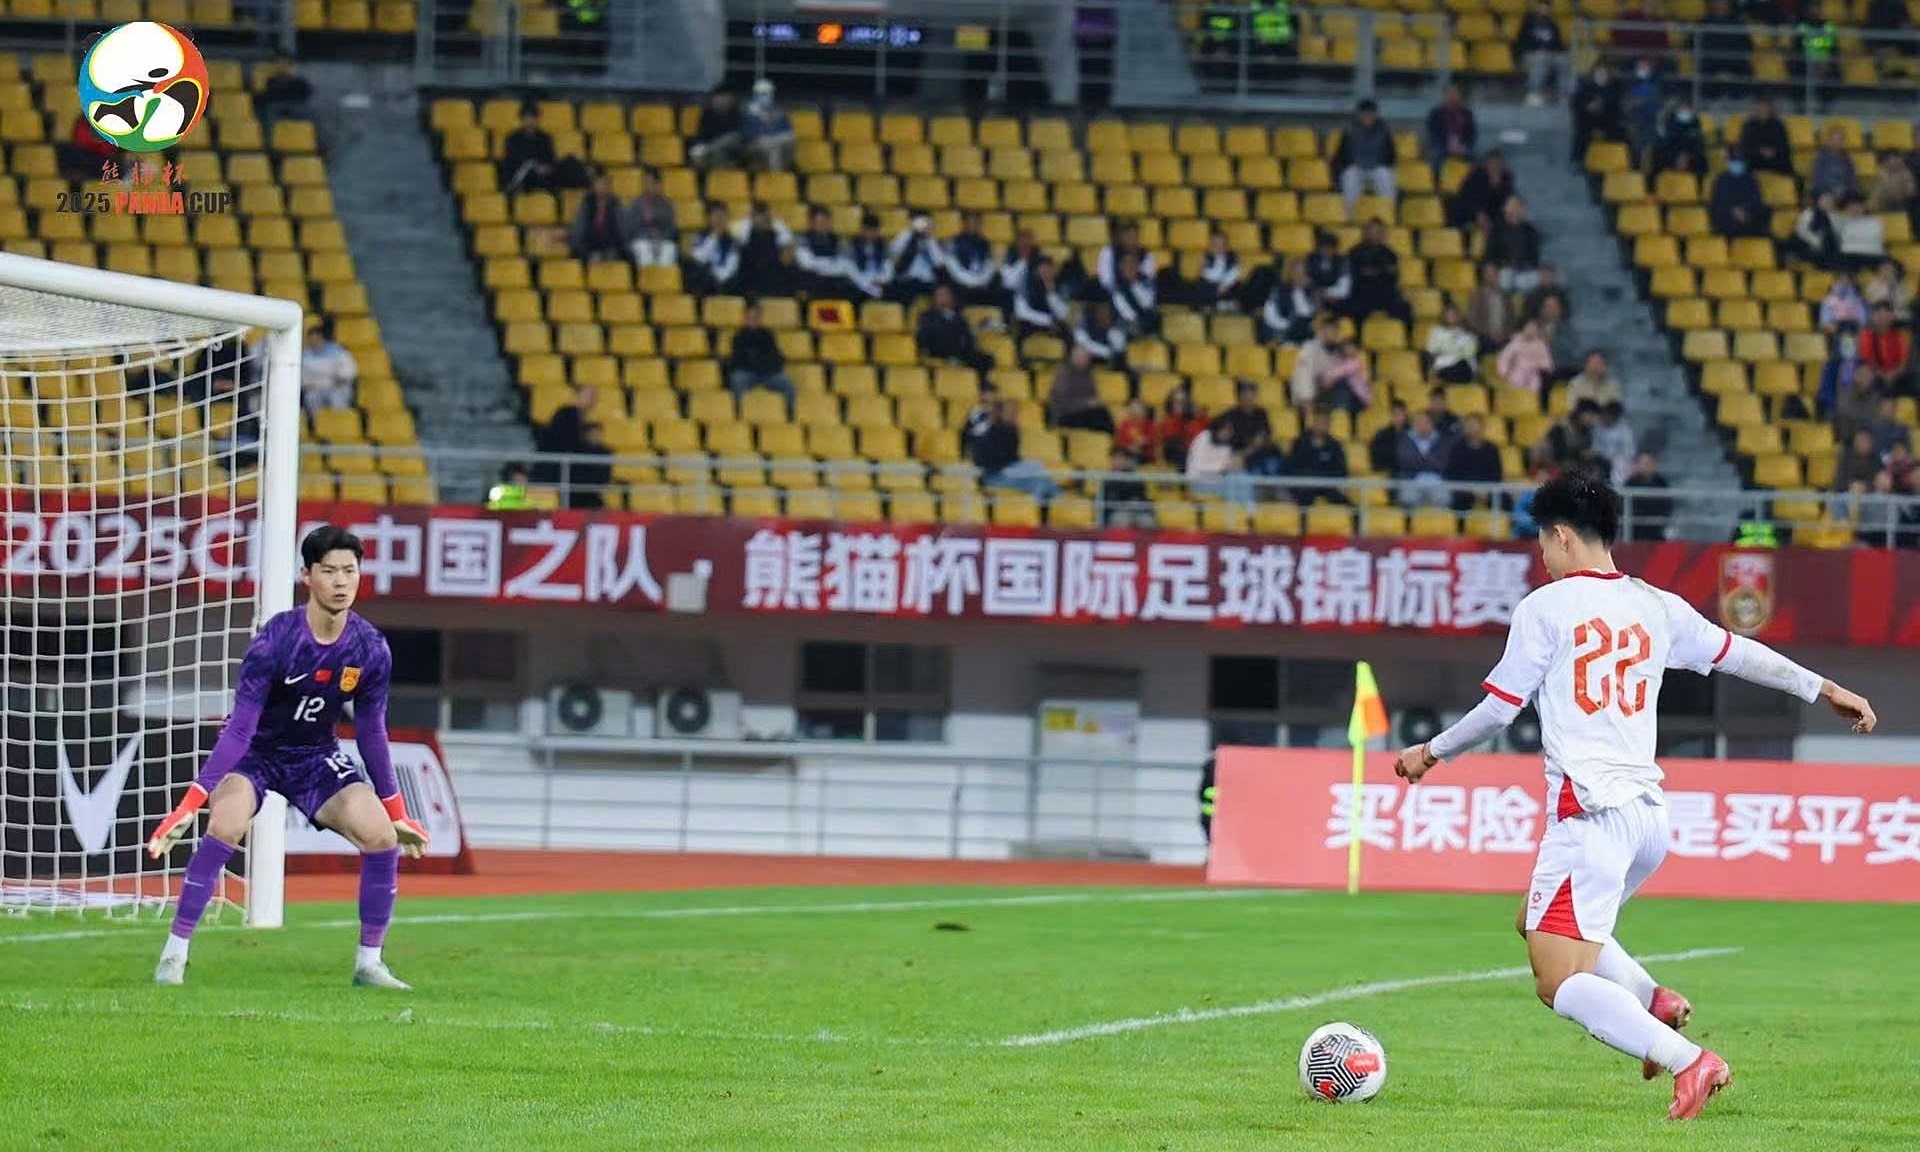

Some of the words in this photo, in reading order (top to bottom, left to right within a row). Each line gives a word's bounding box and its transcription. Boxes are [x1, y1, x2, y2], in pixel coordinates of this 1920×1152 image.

[3, 513, 330, 581] 2025C
[1574, 617, 1650, 718] 22
[293, 695, 326, 722] 12
[1325, 782, 1538, 854] 买保险
